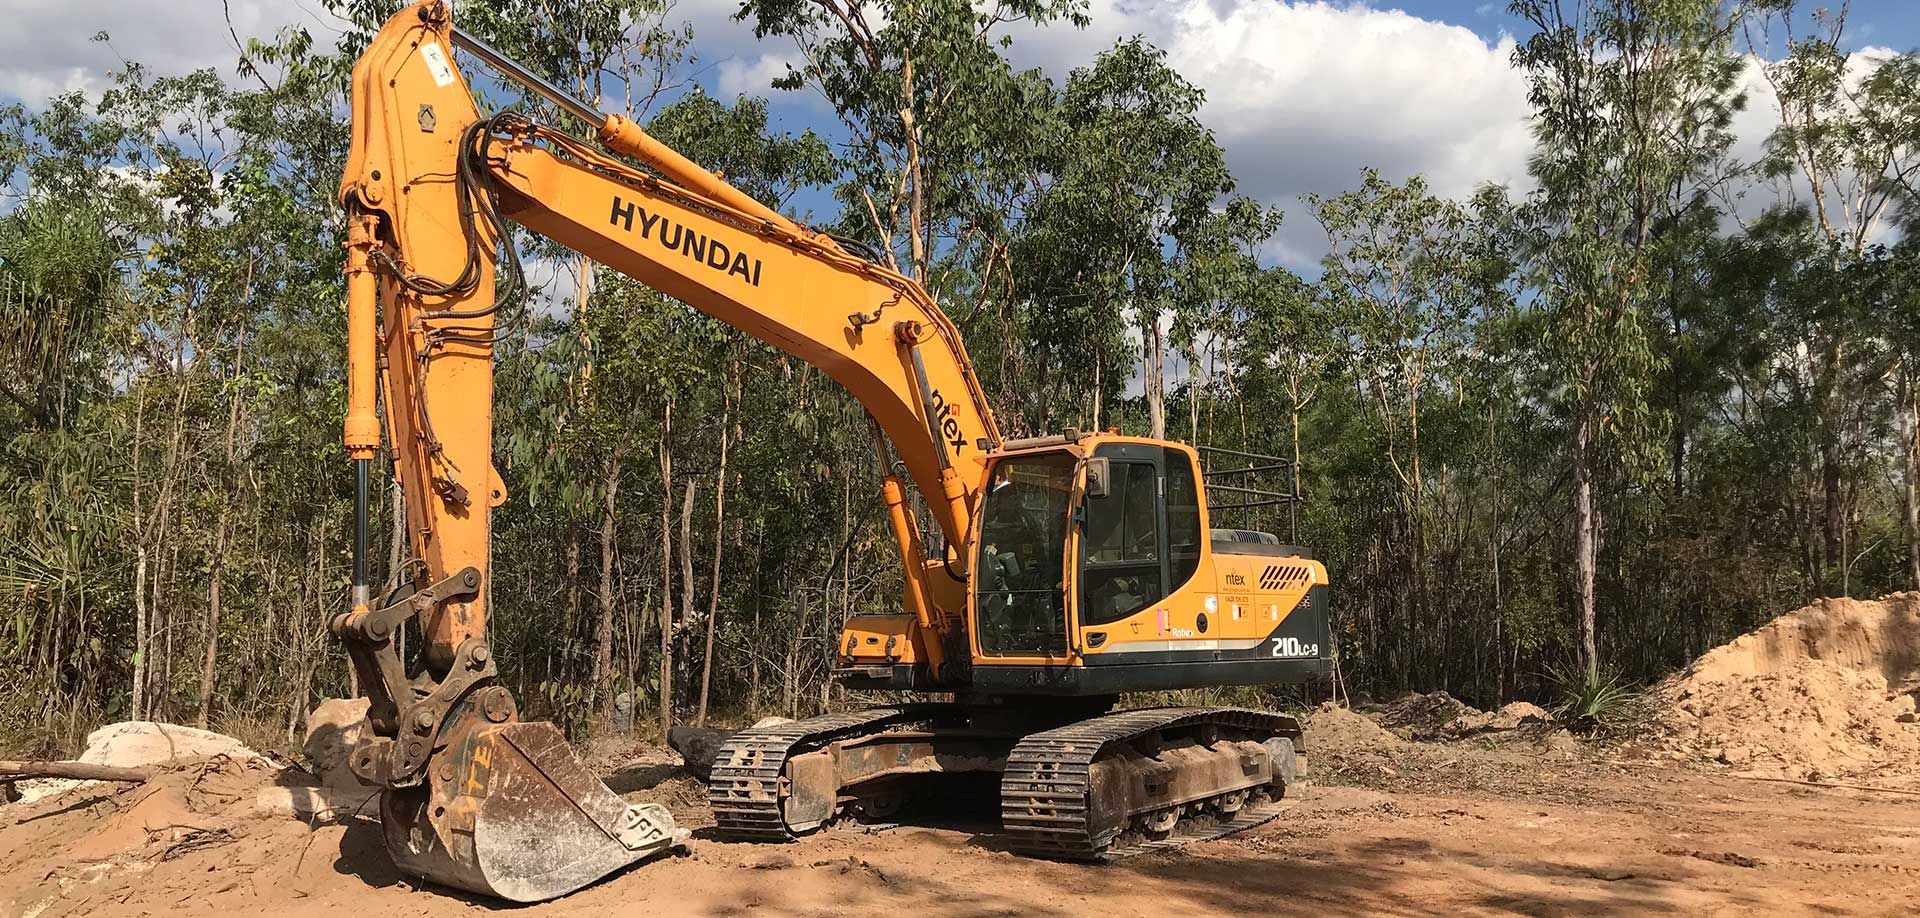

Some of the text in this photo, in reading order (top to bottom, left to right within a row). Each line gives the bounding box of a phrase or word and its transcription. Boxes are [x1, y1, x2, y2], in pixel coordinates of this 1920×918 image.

[610, 196, 762, 287] HYUNDAI
[932, 388, 968, 457] ntex
[1225, 572, 1245, 586] ntex
